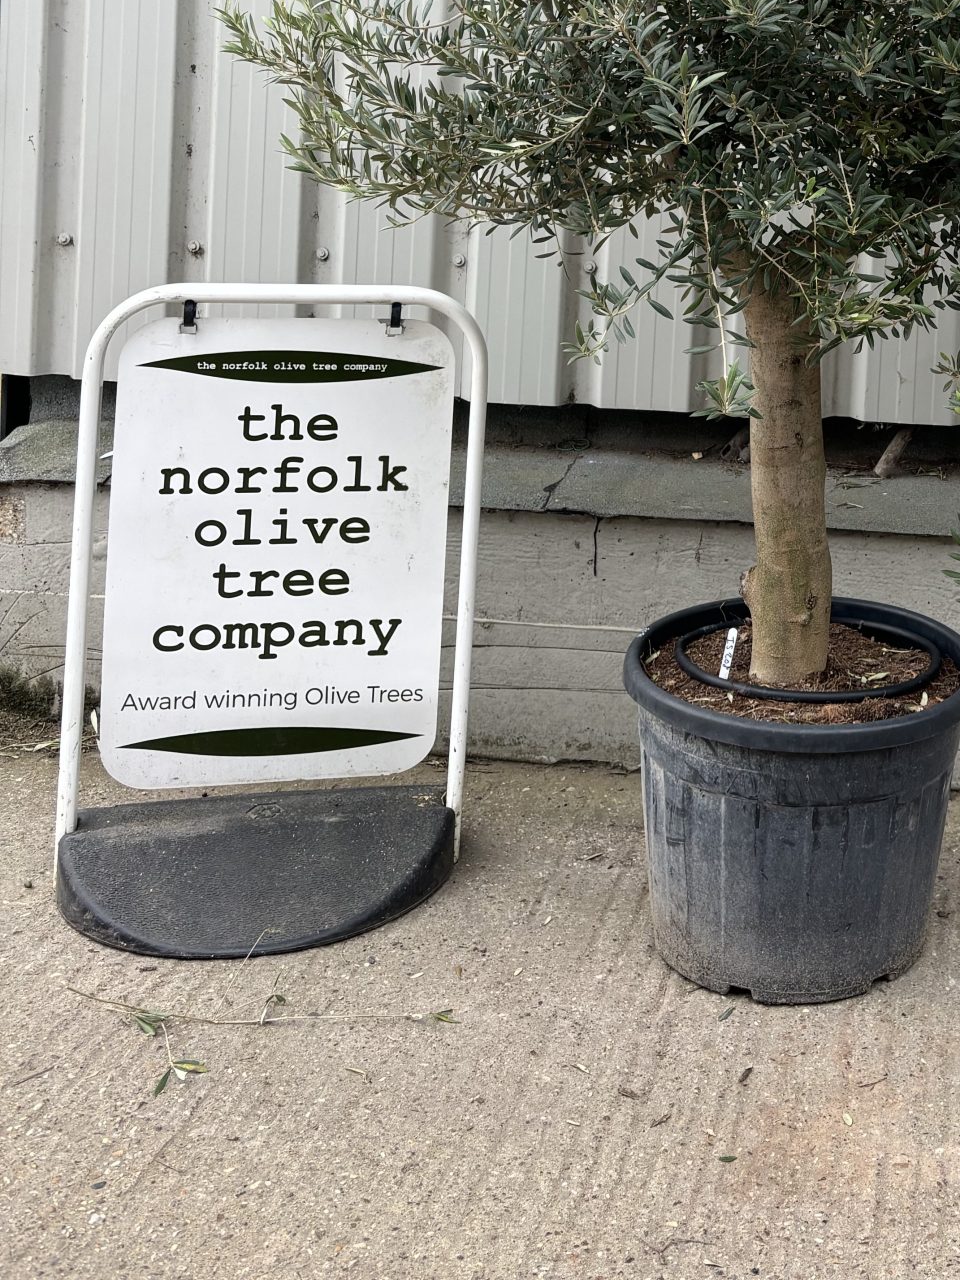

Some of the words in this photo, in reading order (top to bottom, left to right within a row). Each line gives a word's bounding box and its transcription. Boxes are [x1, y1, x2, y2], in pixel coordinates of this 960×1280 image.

[197, 361, 216, 370] the
[222, 361, 268, 371] norfolk
[274, 361, 306, 371] olive
[312, 362, 338, 371] tree
[343, 363, 388, 373] company
[237, 404, 339, 442] the
[158, 455, 409, 495] norfolk
[194, 508, 371, 547] olive
[212, 563, 350, 599] tree
[152, 618, 402, 660] company
[120, 690, 197, 712] Award
[204, 687, 298, 711] winning
[304, 684, 361, 705] Olive
[366, 684, 424, 704] Trees
